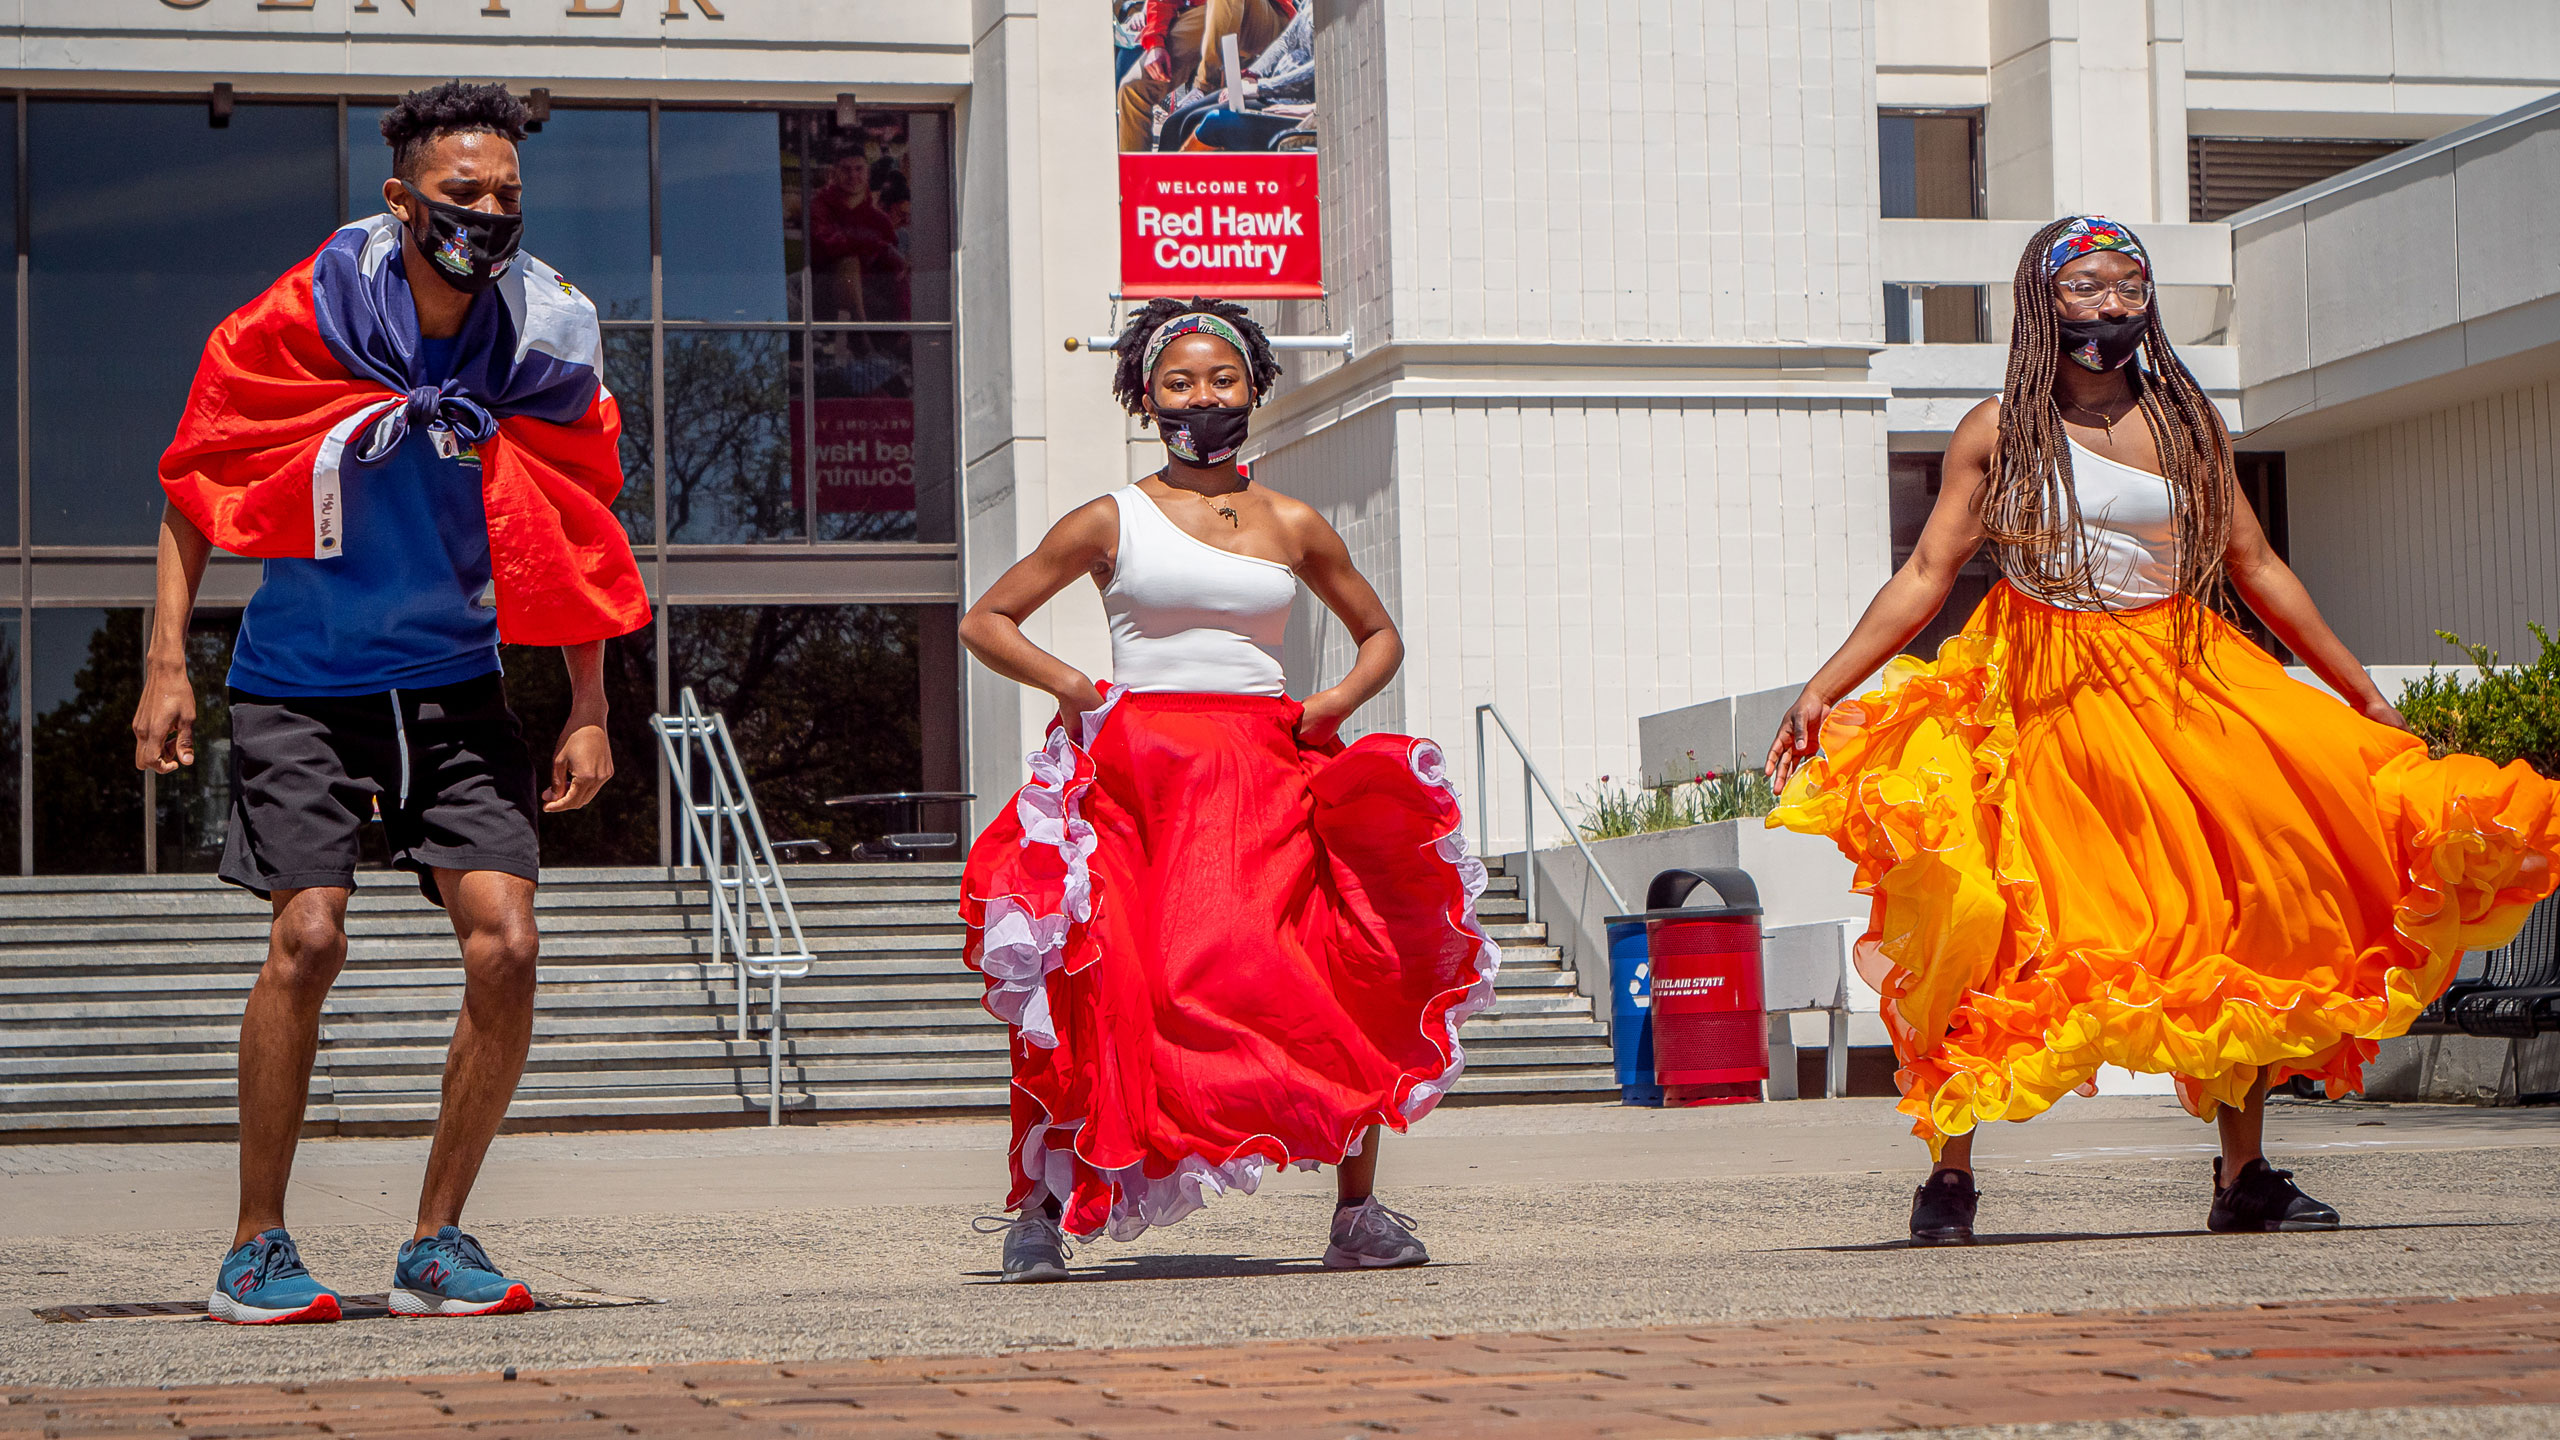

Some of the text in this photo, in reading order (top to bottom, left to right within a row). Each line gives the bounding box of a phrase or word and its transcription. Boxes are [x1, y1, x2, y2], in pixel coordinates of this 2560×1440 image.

[1157, 181, 1280, 194] WELCOME TO
[1136, 206, 1304, 237] Red Hawk
[1153, 238, 1288, 276] Country
[322, 493, 334, 515] MSU
[1693, 977, 1725, 987] STATE
